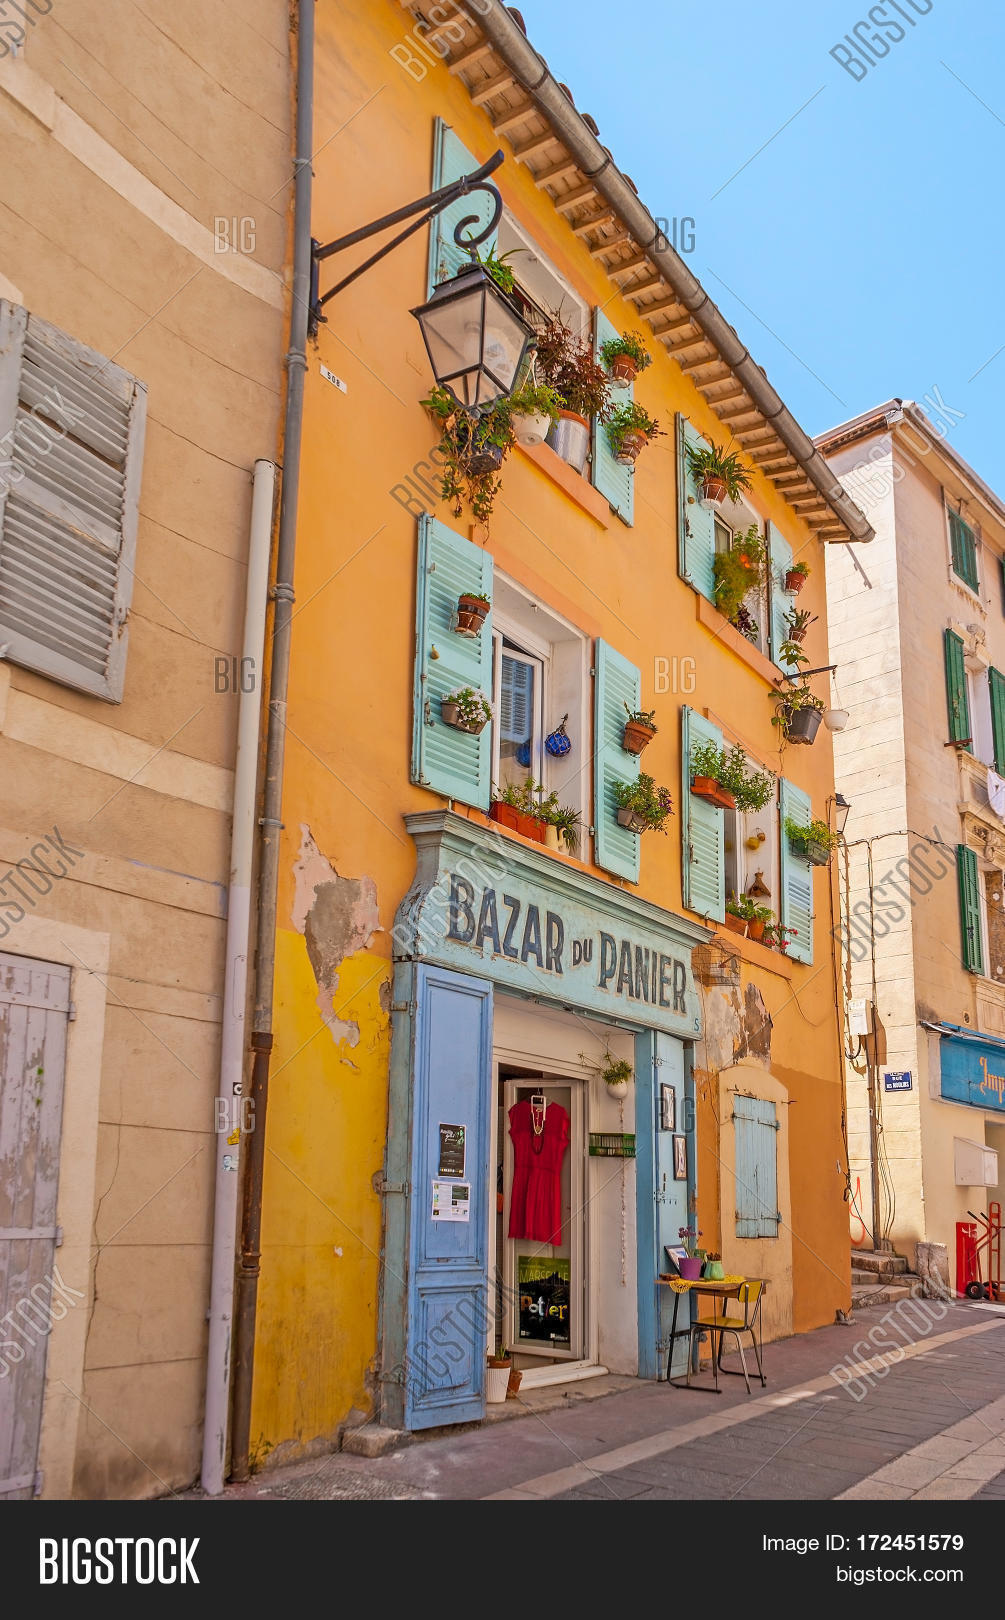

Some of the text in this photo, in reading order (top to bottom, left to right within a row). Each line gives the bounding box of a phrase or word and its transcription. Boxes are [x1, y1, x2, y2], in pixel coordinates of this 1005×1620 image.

[447, 872, 687, 1014] BAZAR DU PANIER
[519, 1269, 569, 1287] MARSEILLE
